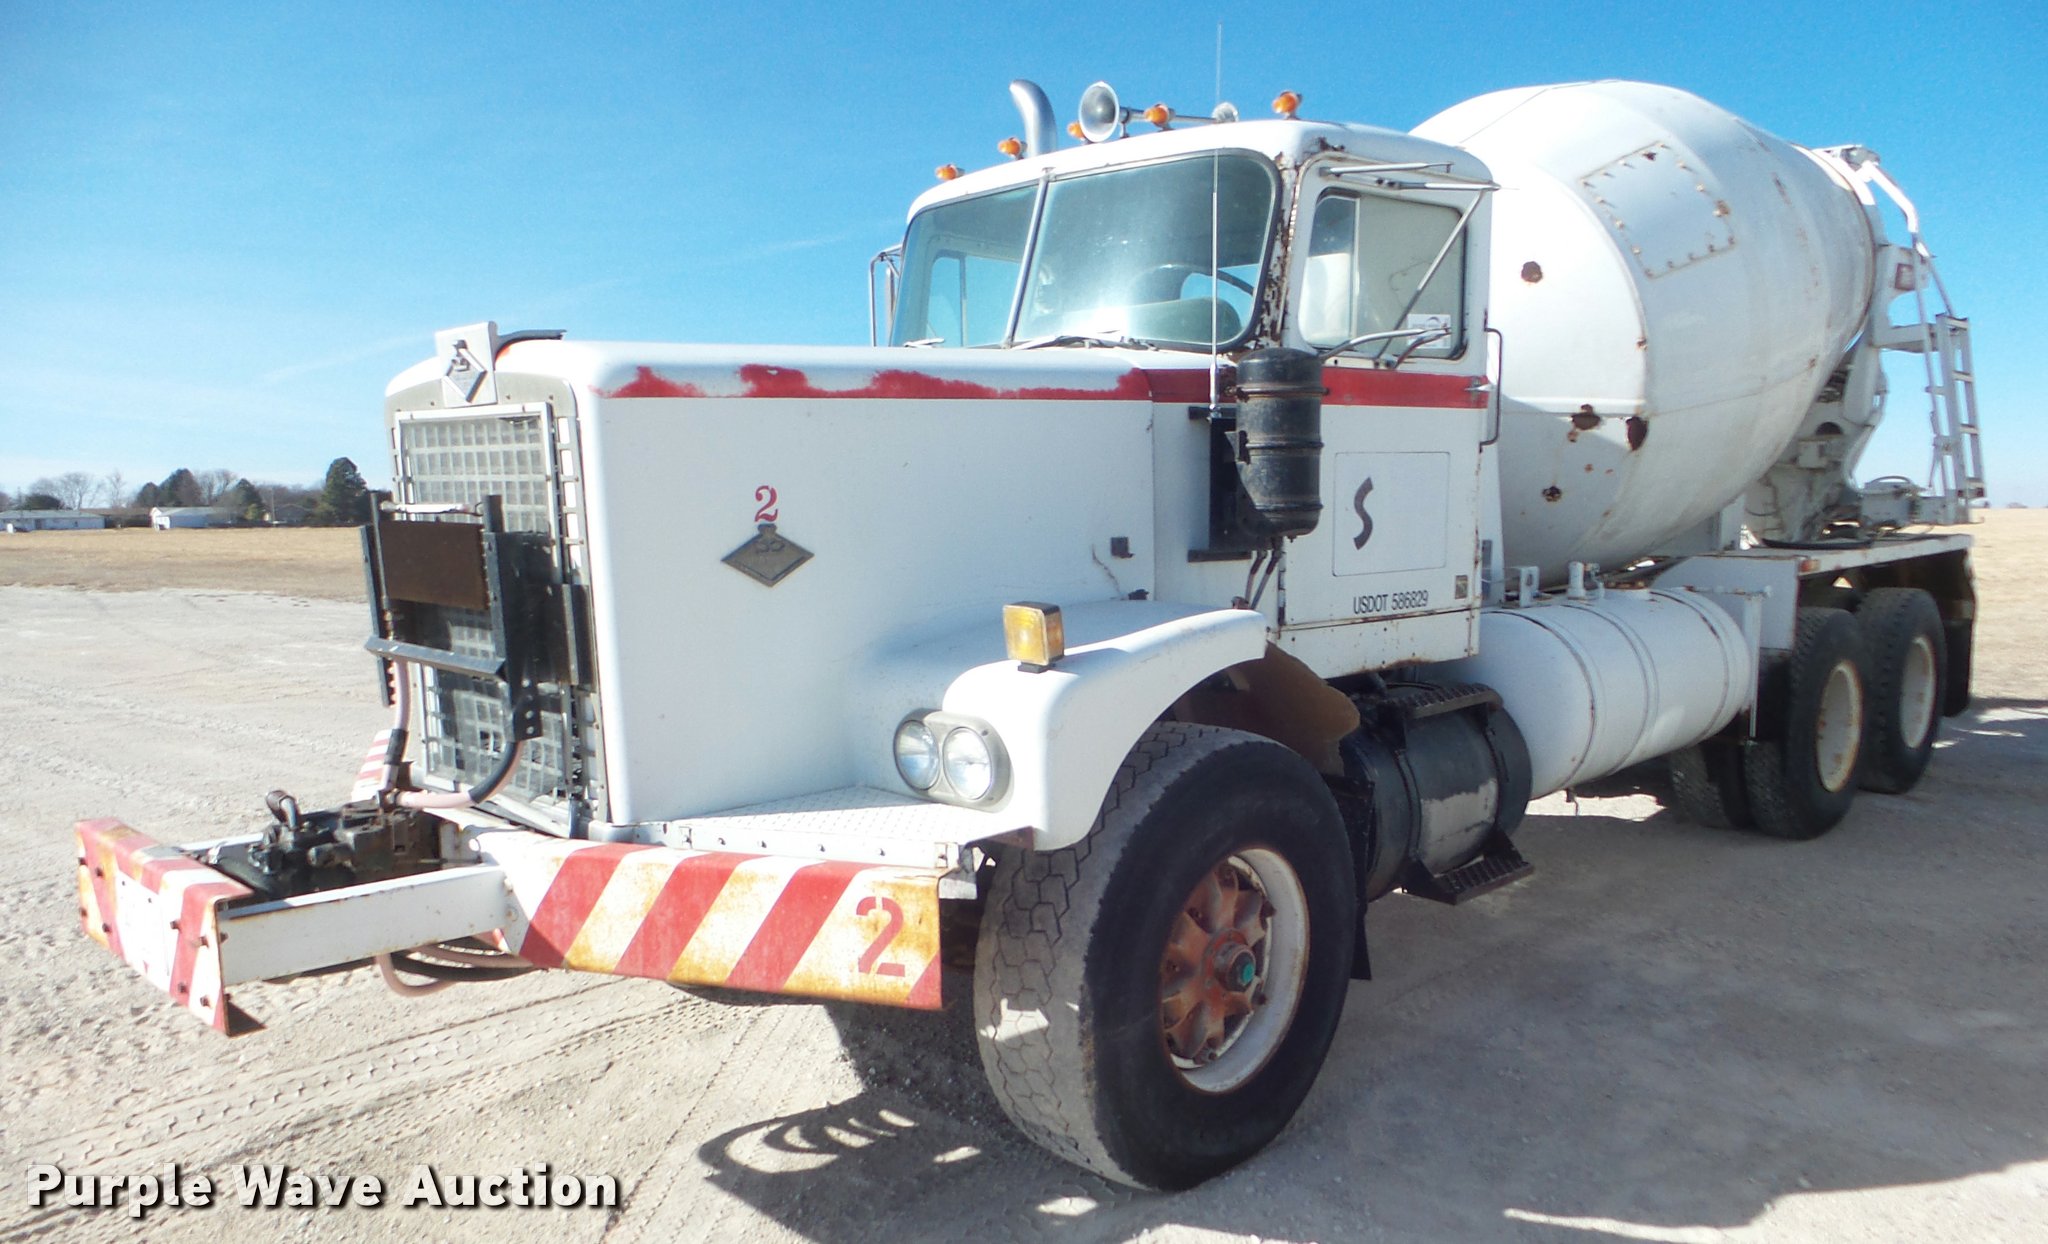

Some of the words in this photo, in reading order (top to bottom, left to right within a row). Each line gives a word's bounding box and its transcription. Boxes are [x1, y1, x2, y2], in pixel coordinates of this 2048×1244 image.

[754, 485, 779, 522] 2
[1353, 594, 1389, 614] USDOT
[1391, 590, 1429, 610] 586829
[856, 896, 906, 977] 2
